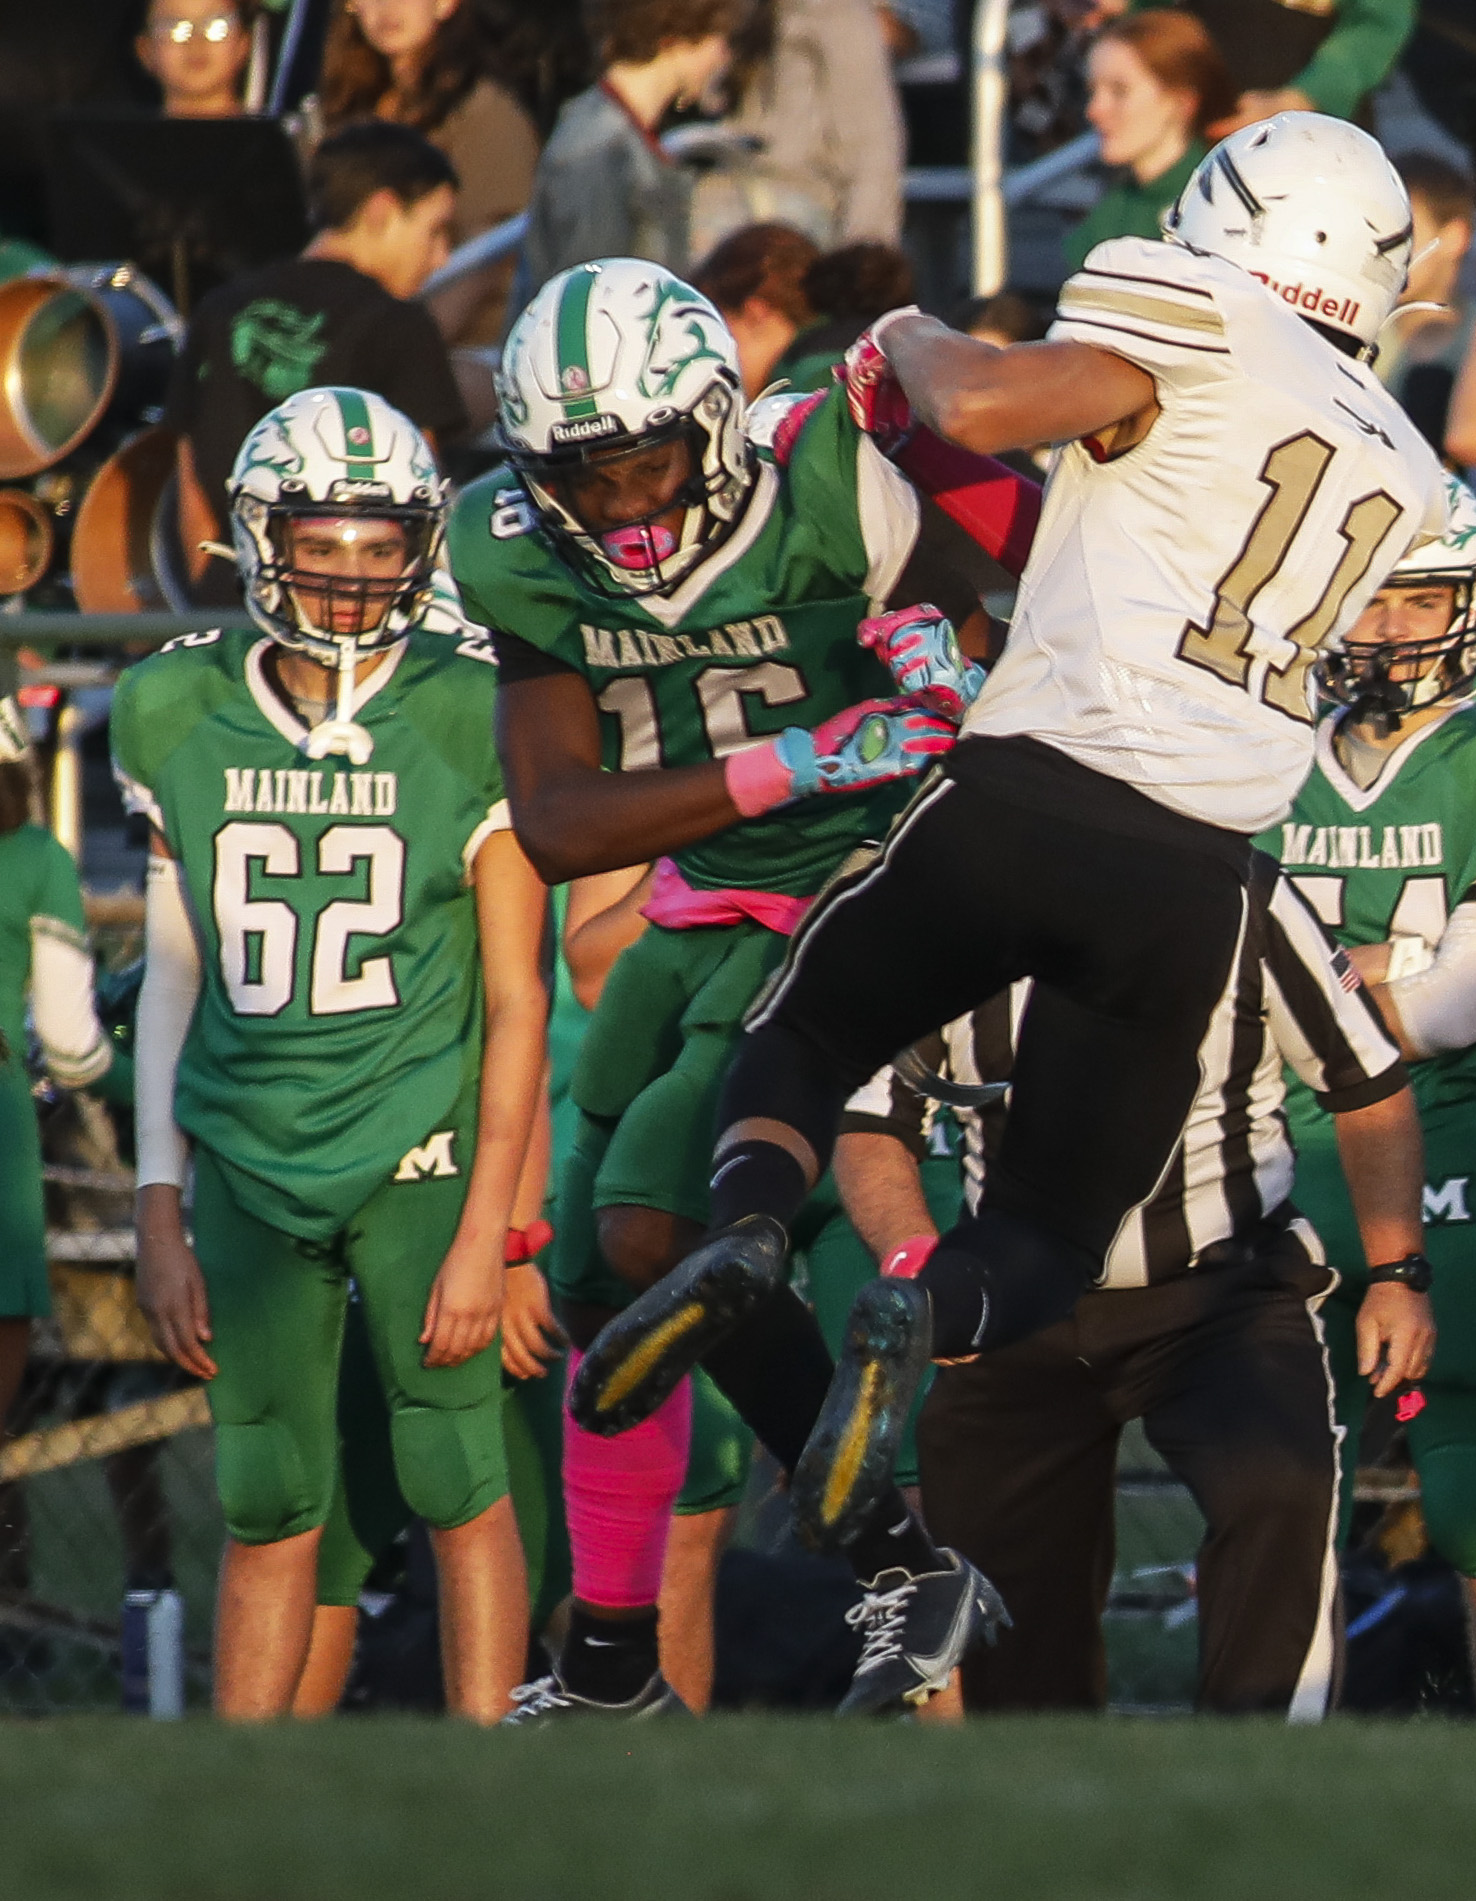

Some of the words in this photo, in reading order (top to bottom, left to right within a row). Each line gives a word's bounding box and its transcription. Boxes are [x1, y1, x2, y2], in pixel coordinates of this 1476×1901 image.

[553, 414, 619, 442] Riddell
[1174, 428, 1404, 729] 11
[579, 614, 790, 669] MAINLAND
[224, 767, 397, 816] MAINLAND
[1281, 822, 1444, 869] MAINLAND
[212, 819, 406, 1017] 62
[393, 1130, 459, 1180] M
[1421, 1175, 1471, 1223] M
